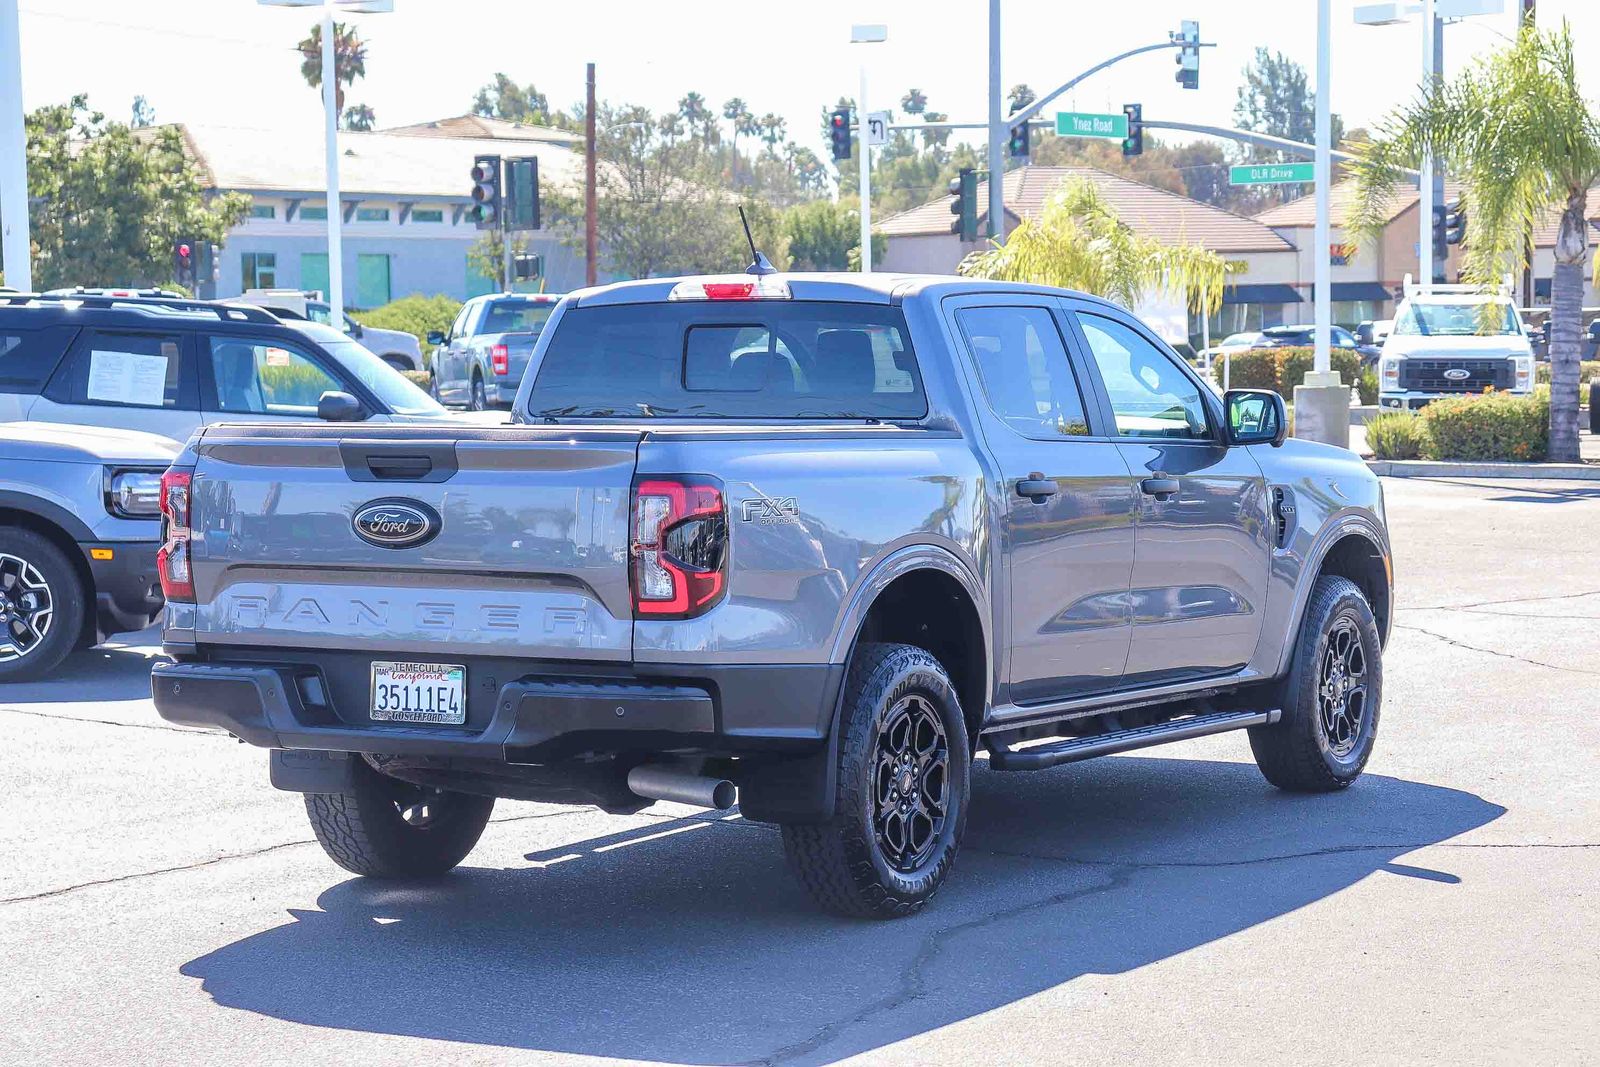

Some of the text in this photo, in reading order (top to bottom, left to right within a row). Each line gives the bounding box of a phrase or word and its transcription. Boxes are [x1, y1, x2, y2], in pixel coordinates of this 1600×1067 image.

[1073, 117, 1113, 133] Ynez Road
[1271, 167, 1293, 179] Drive
[741, 496, 799, 524] FX4
[370, 512, 410, 533] Ford
[230, 594, 588, 634] RANGER
[394, 662, 443, 673] TEMECULA
[378, 684, 458, 713] 35111E4
[422, 712, 443, 723] FORD
